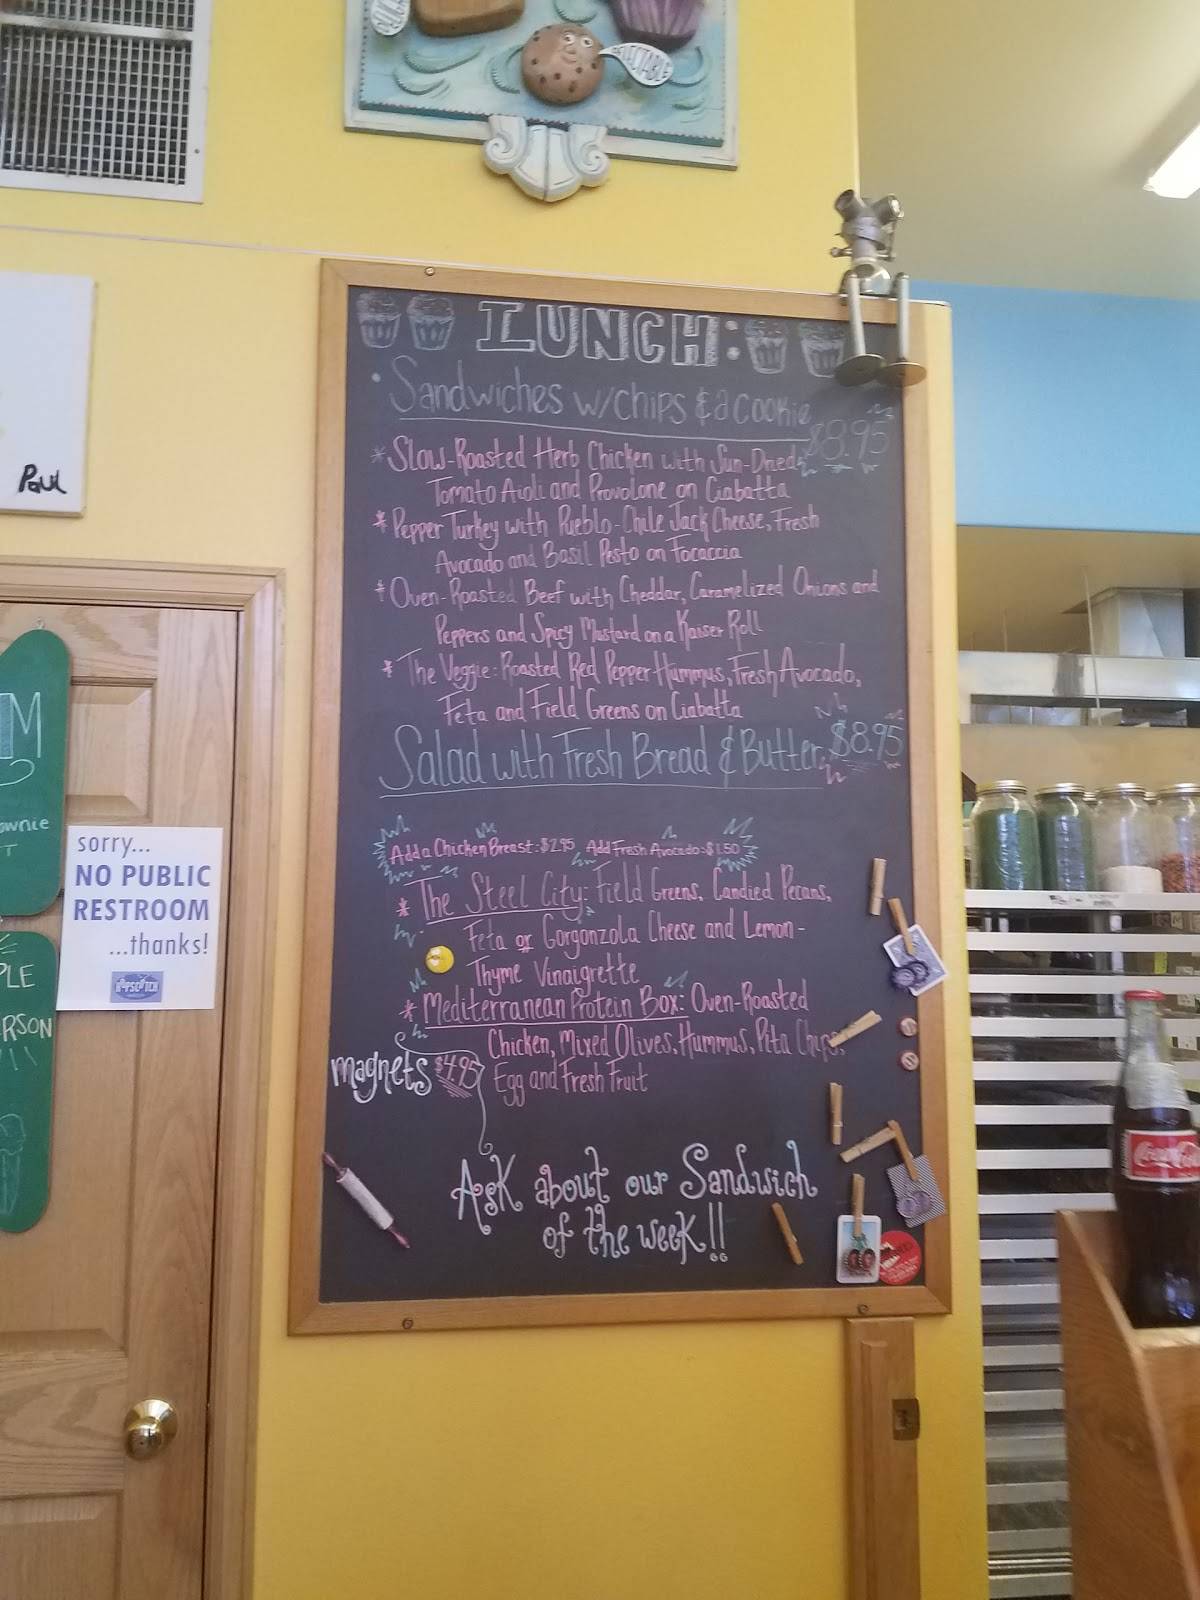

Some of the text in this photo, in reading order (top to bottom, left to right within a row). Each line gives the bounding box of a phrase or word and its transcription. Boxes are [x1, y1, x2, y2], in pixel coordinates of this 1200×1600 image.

[476, 301, 740, 366] LUNCH:
[389, 355, 564, 415] Sandwiches
[533, 436, 580, 470] Herb
[587, 440, 653, 475] Chicken
[661, 447, 705, 473] with
[18, 464, 67, 494] Paul
[426, 476, 497, 507] Tomato
[549, 469, 580, 501] and
[589, 472, 667, 502] Provolone
[675, 482, 698, 500] on
[705, 475, 790, 503] Ciabatta
[392, 506, 444, 545] Pepper
[441, 509, 499, 551] Turkey
[504, 507, 548, 537] with
[669, 500, 710, 542] Jack
[770, 503, 820, 531] Fresh
[434, 533, 743, 577] Avocado and Basil Pesto on Focaccia
[524, 578, 566, 606] Beef
[570, 585, 614, 610] with
[690, 565, 783, 600] Caramelized
[793, 566, 847, 598] Onions
[852, 569, 880, 594] and
[435, 614, 490, 648] Peppers
[496, 613, 527, 643] and
[531, 612, 573, 649] Spicy
[579, 613, 641, 645] Mustard
[644, 629, 662, 643] on
[664, 630, 677, 643] a
[728, 609, 763, 651] Roll
[396, 648, 437, 686] The
[500, 650, 561, 687] Roasted
[568, 646, 600, 689] Red
[604, 649, 650, 688] Pepper
[727, 650, 777, 698] Fresh
[437, 683, 743, 726] Feta and Field Greens on Ciabatta
[379, 724, 486, 790] Salad
[492, 729, 555, 779] with
[552, 727, 622, 779] Fresh
[632, 725, 711, 779] Bread
[78, 837, 150, 858] sorry...
[388, 844, 421, 865] Add
[434, 837, 486, 858] Chicken
[586, 840, 610, 857] Add
[611, 839, 649, 857] Fresh
[75, 864, 211, 887] NO PUBLIC
[404, 876, 454, 921] The
[465, 871, 529, 914] Steel
[593, 861, 643, 904] Field
[712, 867, 773, 901] Candied
[74, 899, 209, 921] RESTROOM
[110, 932, 208, 955] ...thanks!
[463, 918, 507, 952] Feta
[516, 934, 533, 952] or
[542, 913, 641, 959] Gorgonzola
[648, 910, 697, 942] Cheese
[704, 907, 737, 940] and
[466, 952, 640, 998] Thyme Vinaigrette
[423, 984, 567, 1025] Mediterranean
[570, 987, 632, 1021] Protein
[559, 1024, 612, 1057] Mixed
[755, 1016, 792, 1055] Pita
[331, 1051, 432, 1103] magnets
[493, 1056, 648, 1107] Egg and Fresh Fruit
[534, 1146, 610, 1209] about
[625, 1172, 668, 1197] our
[680, 1139, 818, 1199] Sandwich
[543, 1211, 574, 1258] of
[583, 1203, 630, 1258] the
